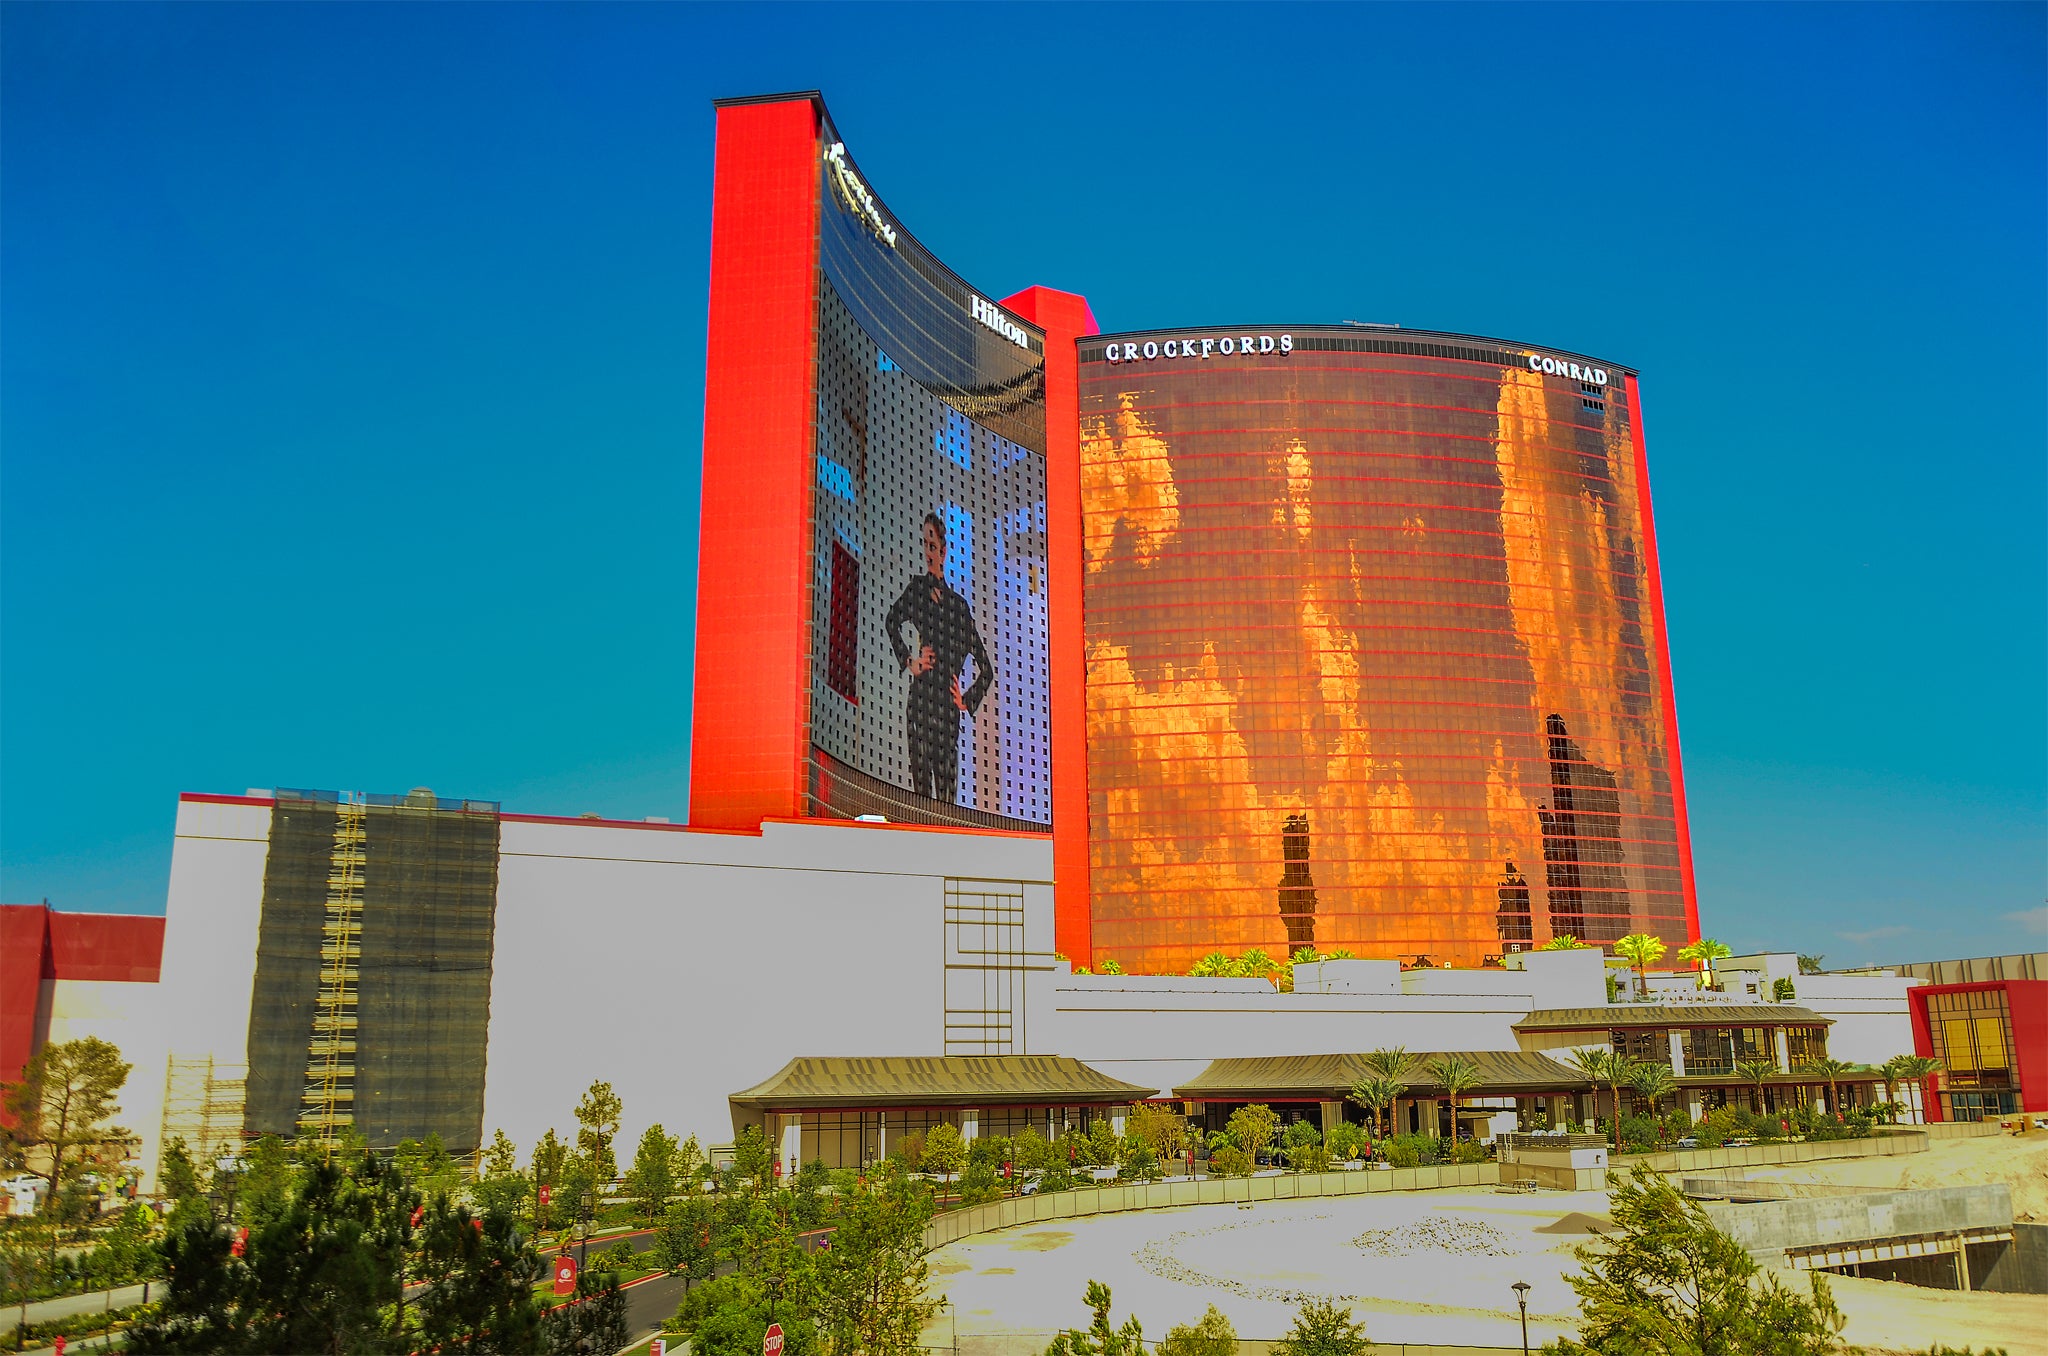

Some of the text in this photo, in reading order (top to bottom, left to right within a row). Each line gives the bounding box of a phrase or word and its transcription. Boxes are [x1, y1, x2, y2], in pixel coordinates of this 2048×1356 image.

[971, 294, 1028, 349] Hilton
[1105, 334, 1293, 361] CROCKFORDS
[1528, 354, 1608, 386] CONRAD
[765, 1334, 783, 1352] STOP
